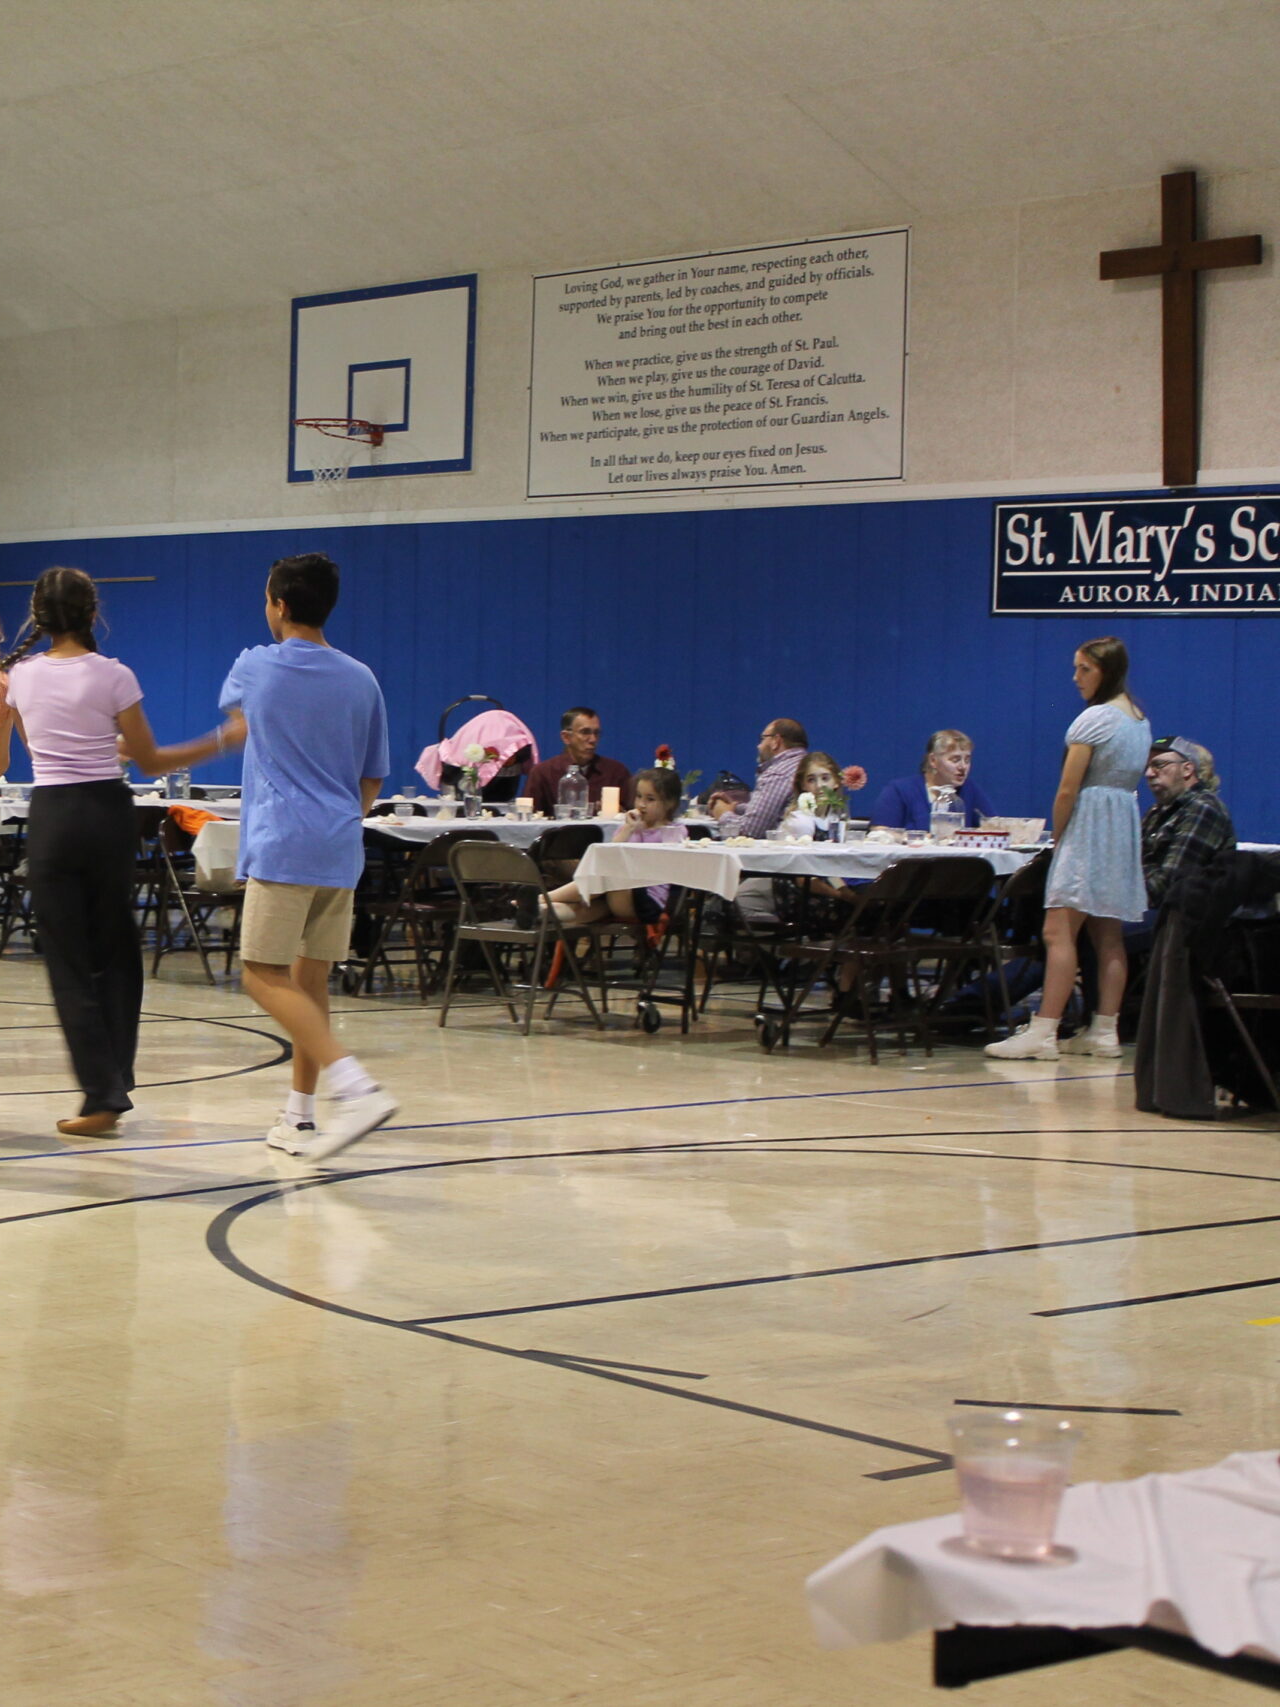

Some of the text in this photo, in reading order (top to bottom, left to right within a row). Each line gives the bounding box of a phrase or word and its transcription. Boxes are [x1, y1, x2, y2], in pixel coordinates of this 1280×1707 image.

[565, 248, 869, 294] Loving God, we gather in Your name, respecting each other,
[559, 265, 874, 313] supported by parents, led by coaches, and guided by officials.
[597, 290, 828, 326] We praise You for the opportunity to compete
[618, 311, 803, 339] and bring out the best in each other.
[584, 336, 839, 370] When we practice, give us the strength of St. Paul.
[597, 356, 825, 386] When we play, give us the courage of David.
[560, 373, 866, 406] When we win, give us the humility of St. Teresa of Calcutta.
[592, 393, 829, 421] When we lose, give us the peace of St. Francis.
[539, 407, 890, 443] When we participate, give us the protection of our Guardian Angels.
[590, 443, 828, 467] In all that we do, keep our eyes fixed on Jesus.
[608, 463, 807, 484] Let our lives always praise You. Amen.
[1005, 513, 1055, 565] St.
[1068, 505, 1216, 582] Mary's
[1058, 583, 1280, 605] AURORA, INDIA
